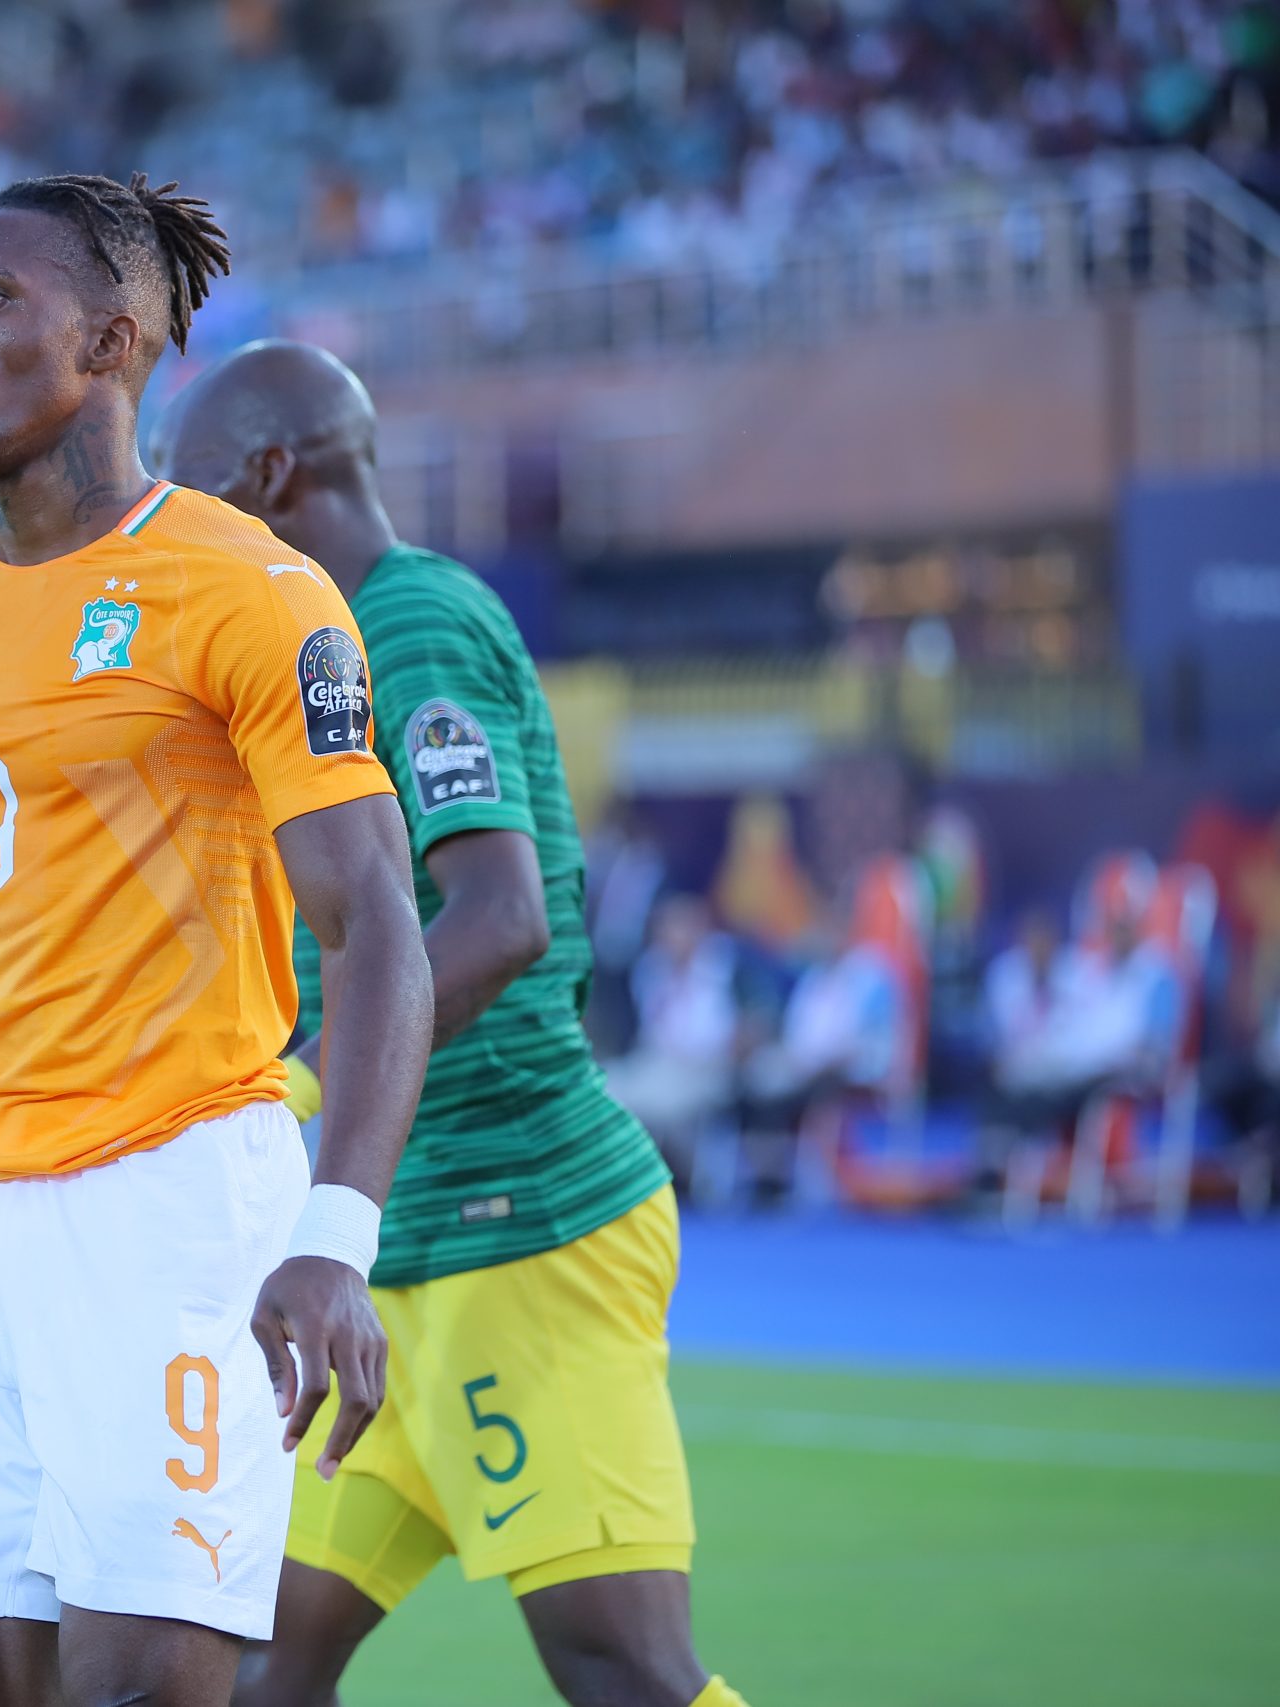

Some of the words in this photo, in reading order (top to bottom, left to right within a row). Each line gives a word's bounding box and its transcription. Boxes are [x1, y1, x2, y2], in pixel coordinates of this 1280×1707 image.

[308, 680, 366, 707] Celebrate
[323, 697, 362, 715] Africa
[165, 1353, 219, 1493] 9
[462, 1373, 528, 1484] 5
